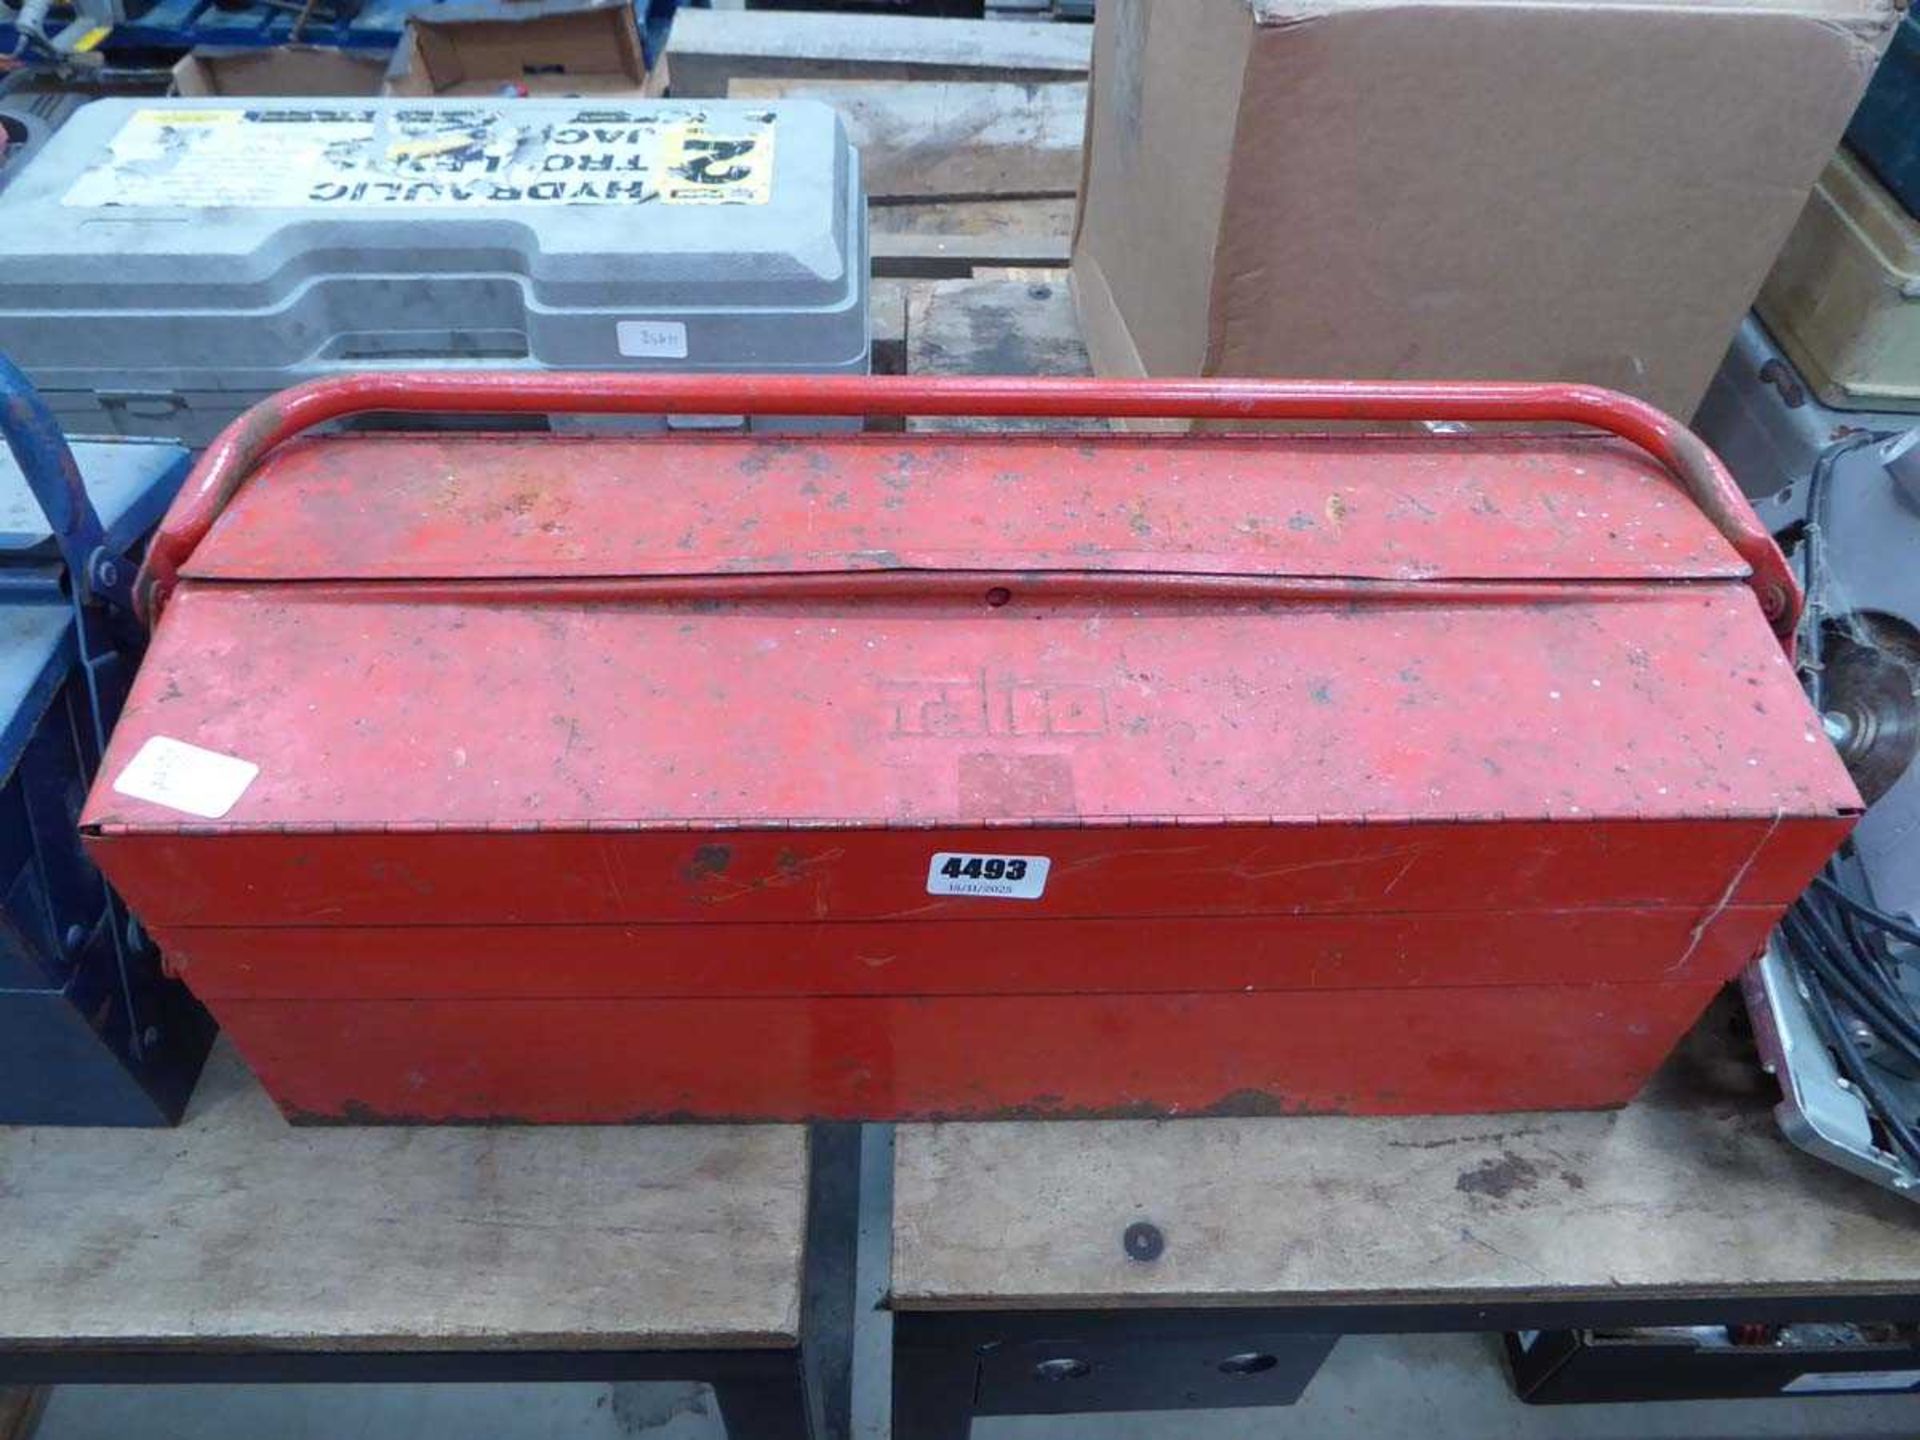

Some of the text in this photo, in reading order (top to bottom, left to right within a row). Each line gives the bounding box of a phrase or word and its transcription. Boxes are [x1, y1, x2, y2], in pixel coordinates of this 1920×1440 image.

[668, 139, 756, 184] 2
[308, 180, 645, 201] HYDRAULIC
[941, 858, 1028, 881] 4493
